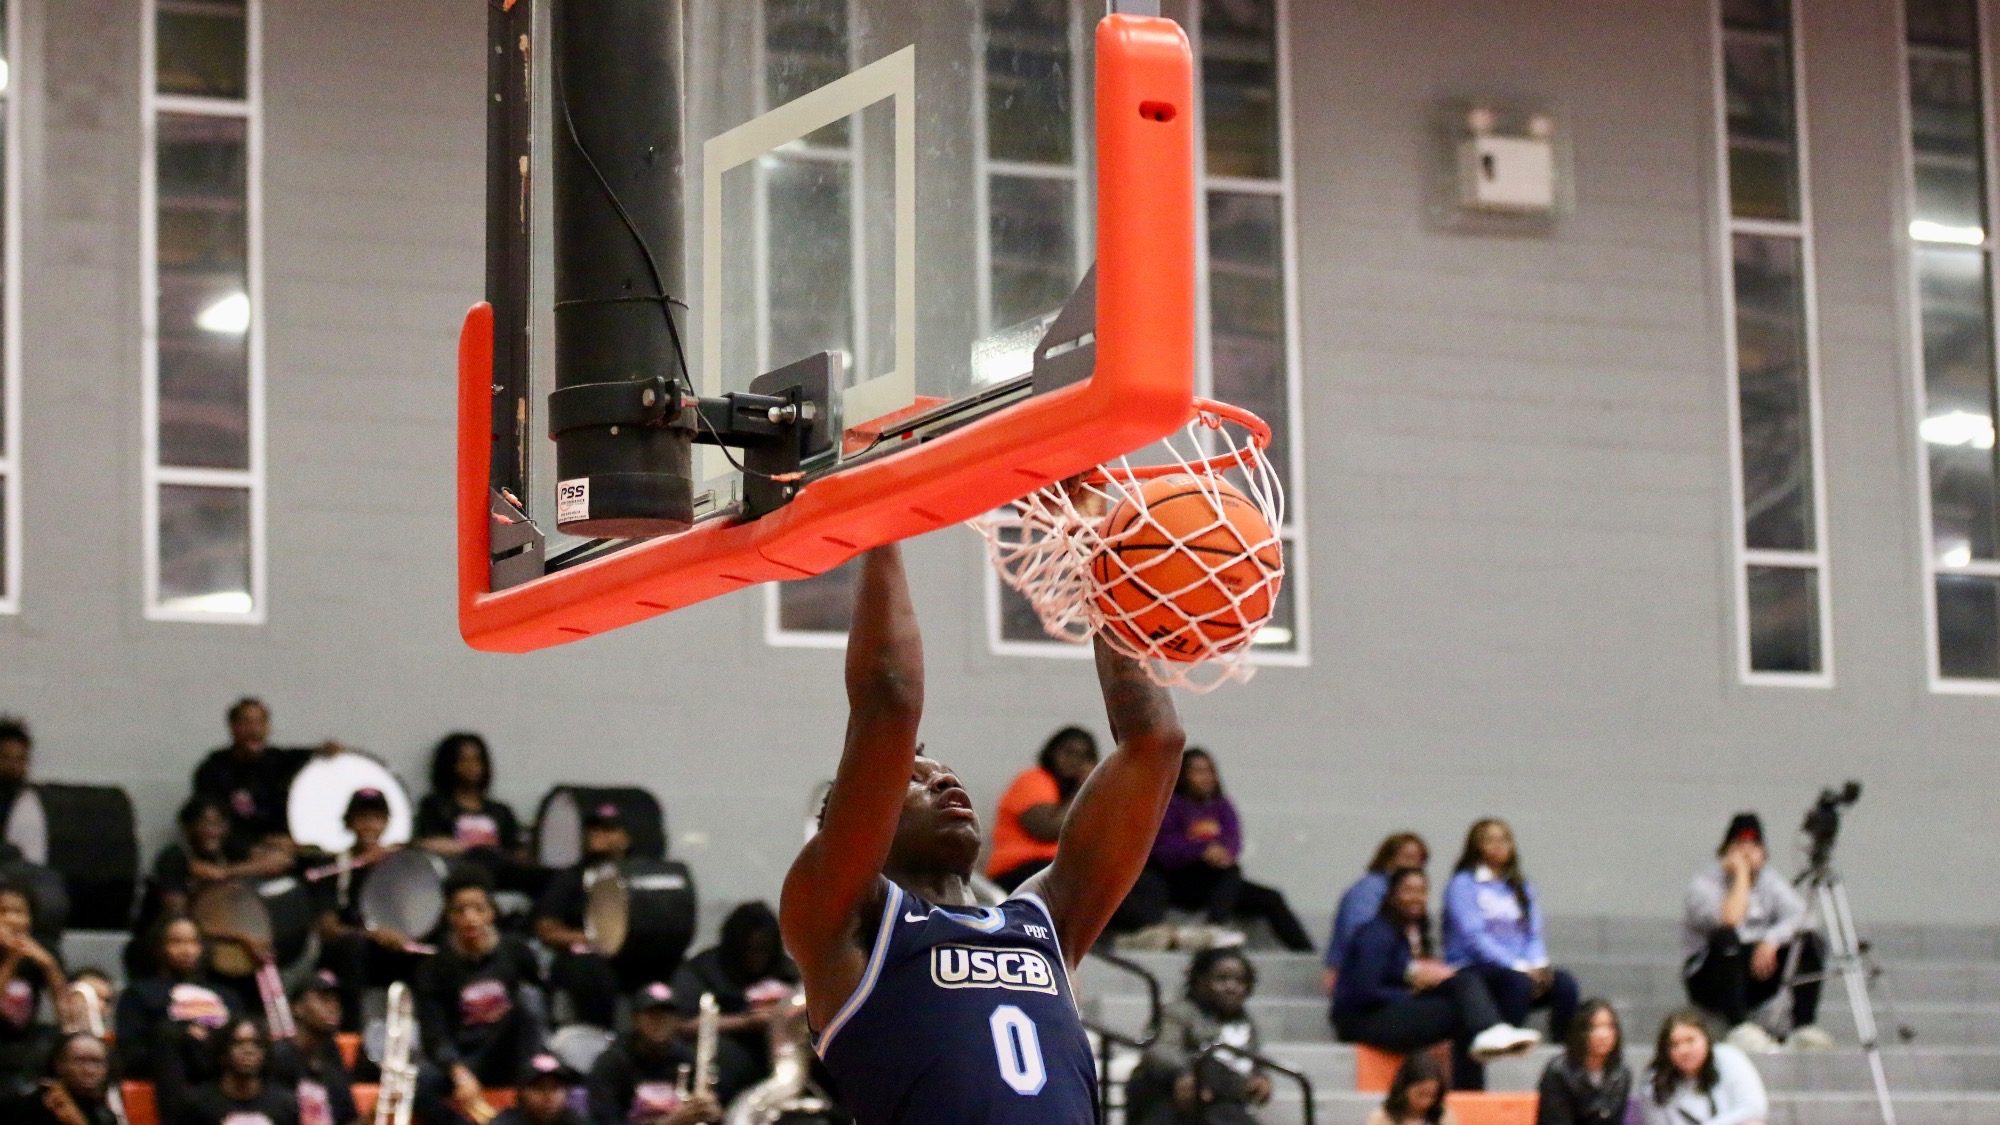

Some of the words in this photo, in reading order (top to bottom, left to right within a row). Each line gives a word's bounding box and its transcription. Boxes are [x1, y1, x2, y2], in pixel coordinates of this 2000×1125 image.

[560, 485, 585, 501] PSS
[1024, 924, 1049, 940] PBC
[938, 947, 1050, 987] USCB
[989, 1004, 1047, 1096] 0
